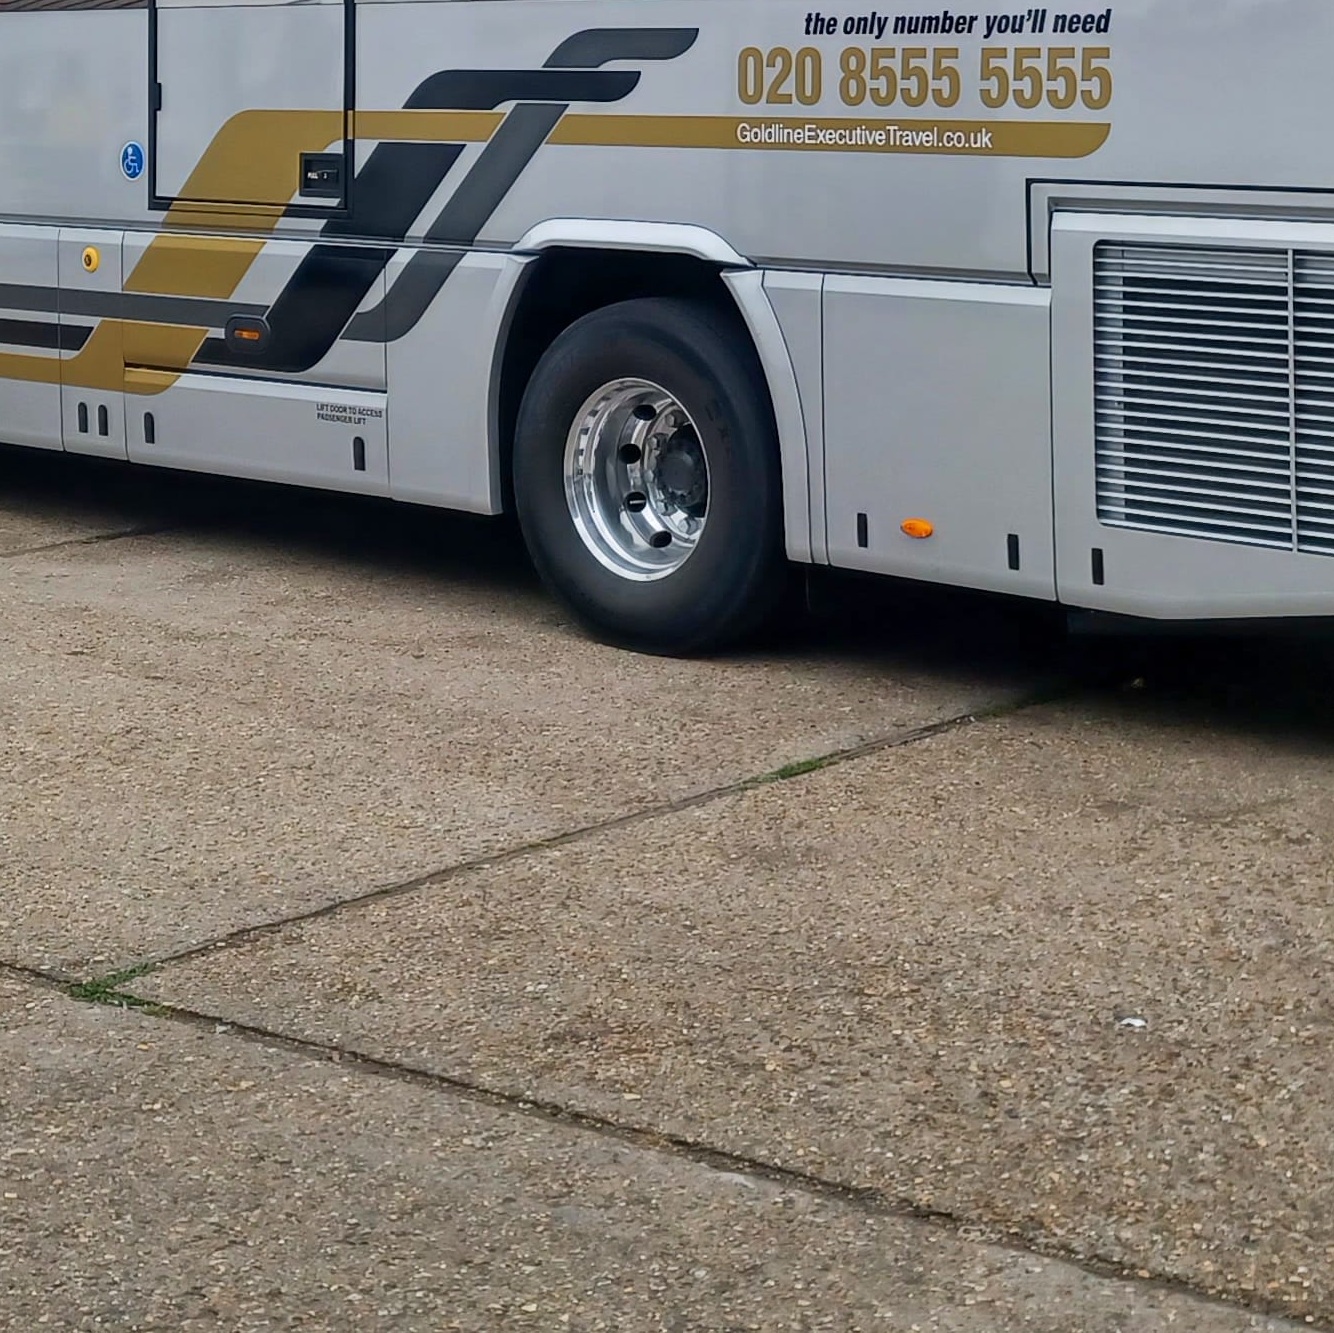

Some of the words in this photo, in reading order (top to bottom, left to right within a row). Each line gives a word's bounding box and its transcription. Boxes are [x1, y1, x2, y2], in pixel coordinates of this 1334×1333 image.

[804, 12, 838, 35] the
[843, 11, 888, 40] only
[893, 10, 978, 35] number
[983, 9, 1047, 39] you'll
[1052, 8, 1112, 34] need
[737, 46, 822, 106] 020
[839, 46, 961, 108] 8555
[979, 47, 1113, 110] 5555
[736, 123, 993, 148] GoldlineExecutiveTravel.co.uk
[316, 403, 328, 412] LIFT
[330, 405, 347, 414] DOOR
[348, 406, 356, 415] TO
[358, 408, 383, 418] ACCESS
[354, 417, 366, 425] LIFT
